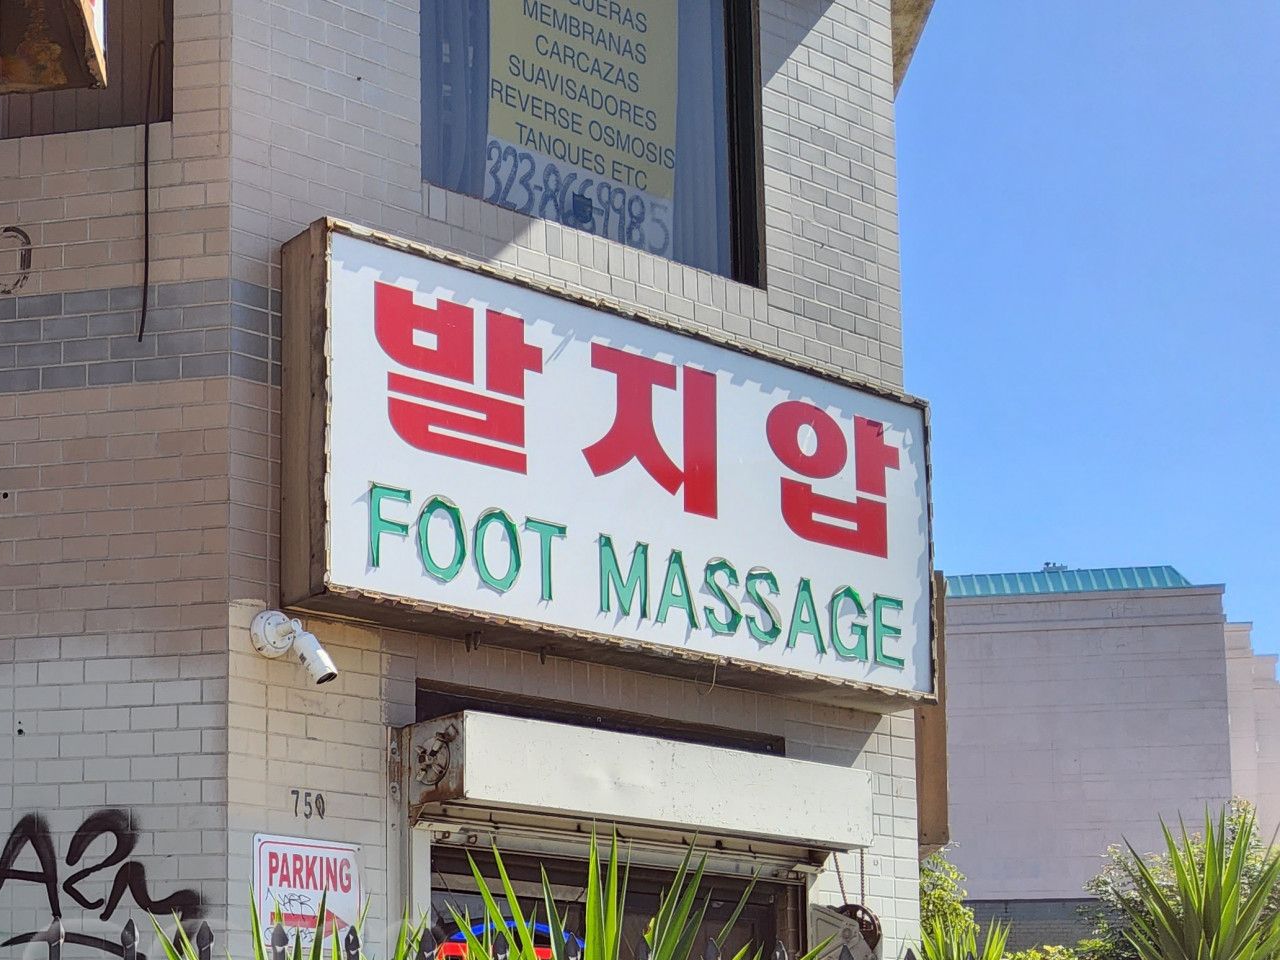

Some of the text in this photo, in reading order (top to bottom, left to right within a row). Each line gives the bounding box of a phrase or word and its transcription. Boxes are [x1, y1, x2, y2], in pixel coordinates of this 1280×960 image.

[522, 0, 647, 65] MEMBRANAS
[570, 0, 648, 33] UERAS
[508, 54, 657, 131] SUAVISADORES
[535, 34, 639, 93] CARCAZAS
[490, 78, 675, 169] REVERSE OSMOSIS
[515, 121, 648, 192] TANQUES ETC
[367, 479, 906, 669] FOOT MASSAGE
[291, 789, 326, 820] 750
[268, 851, 352, 893] PARKING
